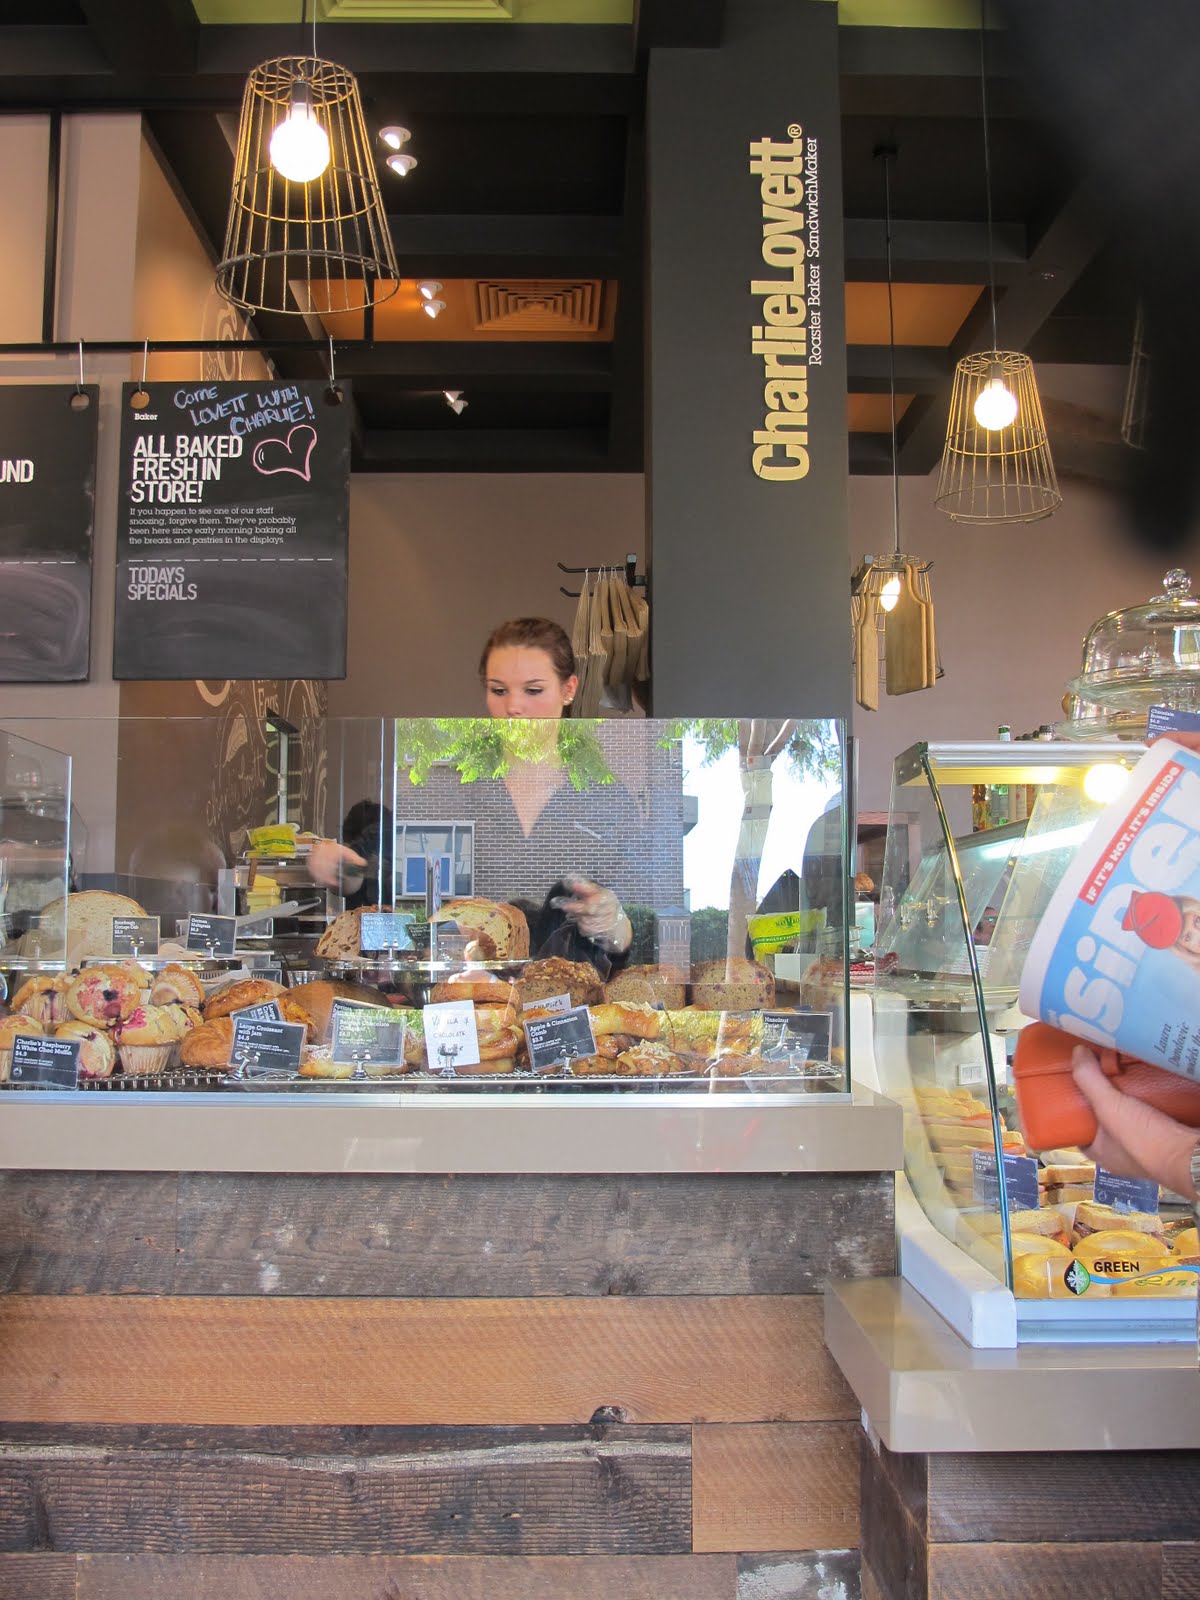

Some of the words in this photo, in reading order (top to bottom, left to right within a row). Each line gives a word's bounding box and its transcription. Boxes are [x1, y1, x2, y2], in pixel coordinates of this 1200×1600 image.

[804, 137, 820, 258] SandwichMaker
[807, 263, 821, 306] Baker
[808, 313, 822, 366] Roaster
[134, 413, 158, 421] Baker
[133, 435, 172, 458] ALL
[176, 435, 243, 458] BAKED
[132, 458, 198, 481] FRESH
[201, 458, 221, 481] IN
[131, 480, 204, 503] STORE!
[137, 508, 153, 517] you
[155, 508, 187, 517] happen
[231, 507, 239, 515] of
[256, 507, 274, 515] staff
[129, 518, 167, 526] snoozing,
[169, 517, 197, 526] forgive
[199, 517, 223, 525] them.
[225, 516, 257, 525] They've
[258, 516, 297, 525] probably
[129, 527, 150, 535] been
[152, 527, 171, 535] here
[172, 526, 193, 535] since
[194, 526, 216, 536] early
[218, 526, 253, 535] morning
[255, 526, 284, 535] baking
[285, 526, 297, 534] all
[129, 536, 143, 544] the
[144, 536, 172, 544] breads
[174, 536, 191, 544] and
[192, 536, 224, 546] pastries
[225, 536, 233, 544] in
[235, 536, 249, 544] the
[250, 535, 284, 545] displays
[129, 566, 185, 584] TODAYS
[128, 583, 198, 601] SPECIALS
[1085, 886, 1098, 901] IF
[1094, 861, 1114, 886] IT'S
[1128, 808, 1150, 831] IT'S
[238, 1023, 256, 1031] Large
[256, 1025, 284, 1034] Croissant
[530, 1023, 546, 1032] Apple
[42, 1040, 72, 1051] Raspberry
[1093, 1261, 1140, 1273] GREEN
